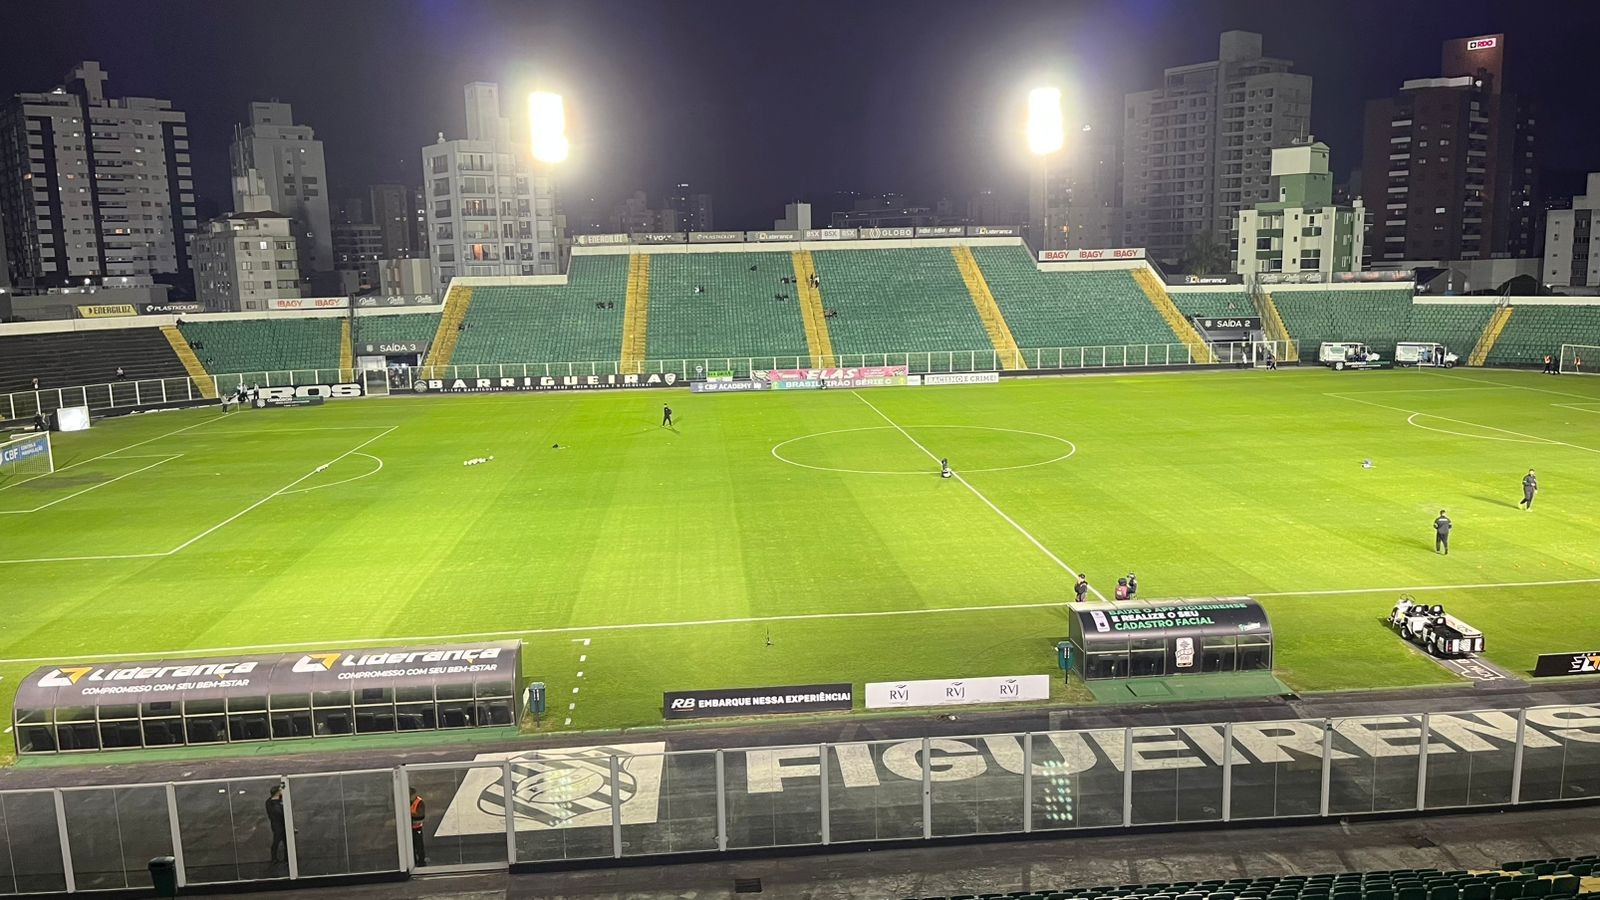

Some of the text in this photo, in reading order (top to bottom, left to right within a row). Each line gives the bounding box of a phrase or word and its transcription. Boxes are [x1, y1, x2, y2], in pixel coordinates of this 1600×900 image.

[1477, 40, 1493, 48] RDO
[1079, 251, 1104, 259] IBAGY
[1113, 250, 1138, 258] IBAGY
[1217, 320, 1251, 328] SAÍDA 2
[379, 343, 417, 352] SAÍDA 3
[806, 369, 858, 380] ELAS
[428, 374, 662, 389] BARRIGUEIRA
[4, 448, 19, 461] CBF
[1178, 603, 1247, 611] FIGUEIRENSE
[1121, 613, 1166, 622] REALIZE
[1115, 617, 1215, 631] CADASTRO FACIAL
[338, 663, 498, 680] COMPROMISSO COM SEU BEM-ESTAR
[82, 678, 250, 695] COMPROMISSO COM SEU BEM-ESTAR
[1000, 684, 1019, 696] RVJ
[890, 690, 909, 701] RVJ
[946, 687, 965, 698] RVJ
[671, 692, 851, 709] RB EMBARQUE NESSA EXPERIÊNCIA!
